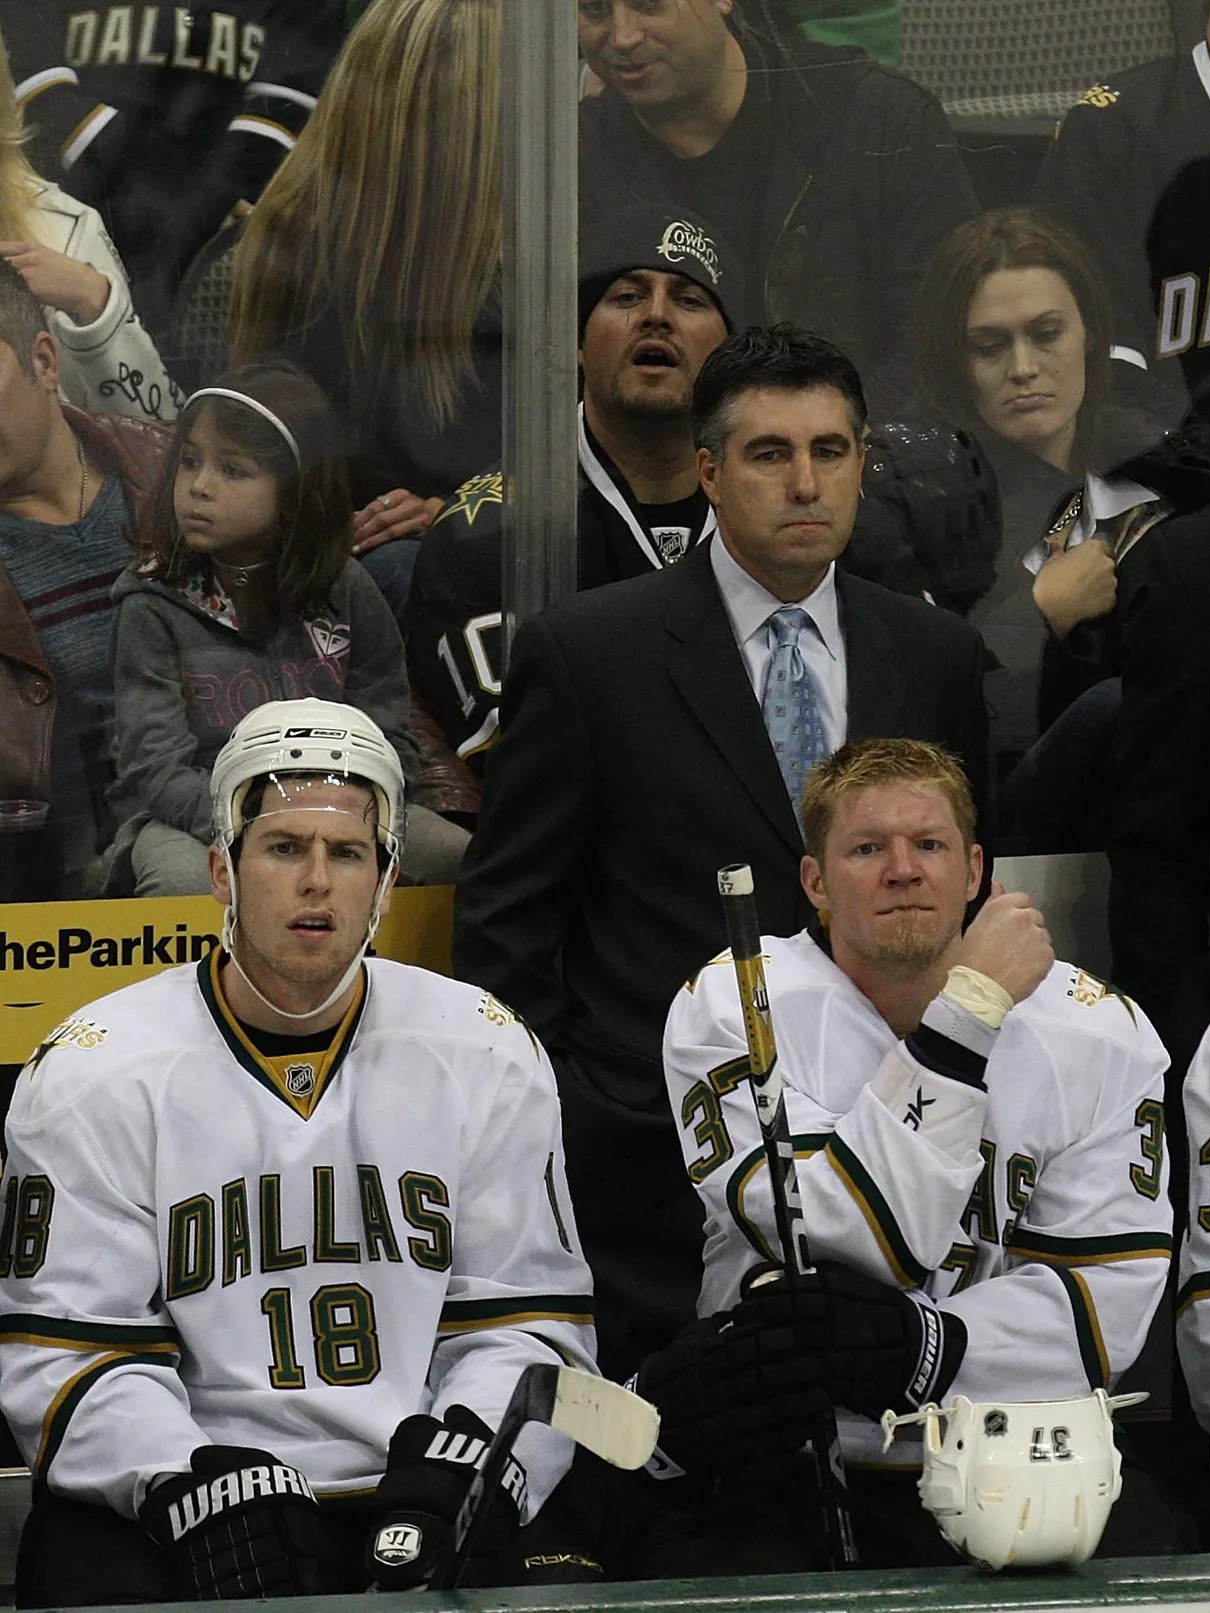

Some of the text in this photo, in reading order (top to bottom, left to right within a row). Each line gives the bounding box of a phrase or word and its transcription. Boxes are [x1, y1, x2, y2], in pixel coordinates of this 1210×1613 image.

[64, 4, 266, 83] DALLAS
[166, 1164, 453, 1300] DALLAS
[261, 1283, 381, 1389] 18
[914, 1309, 941, 1396] BAUER
